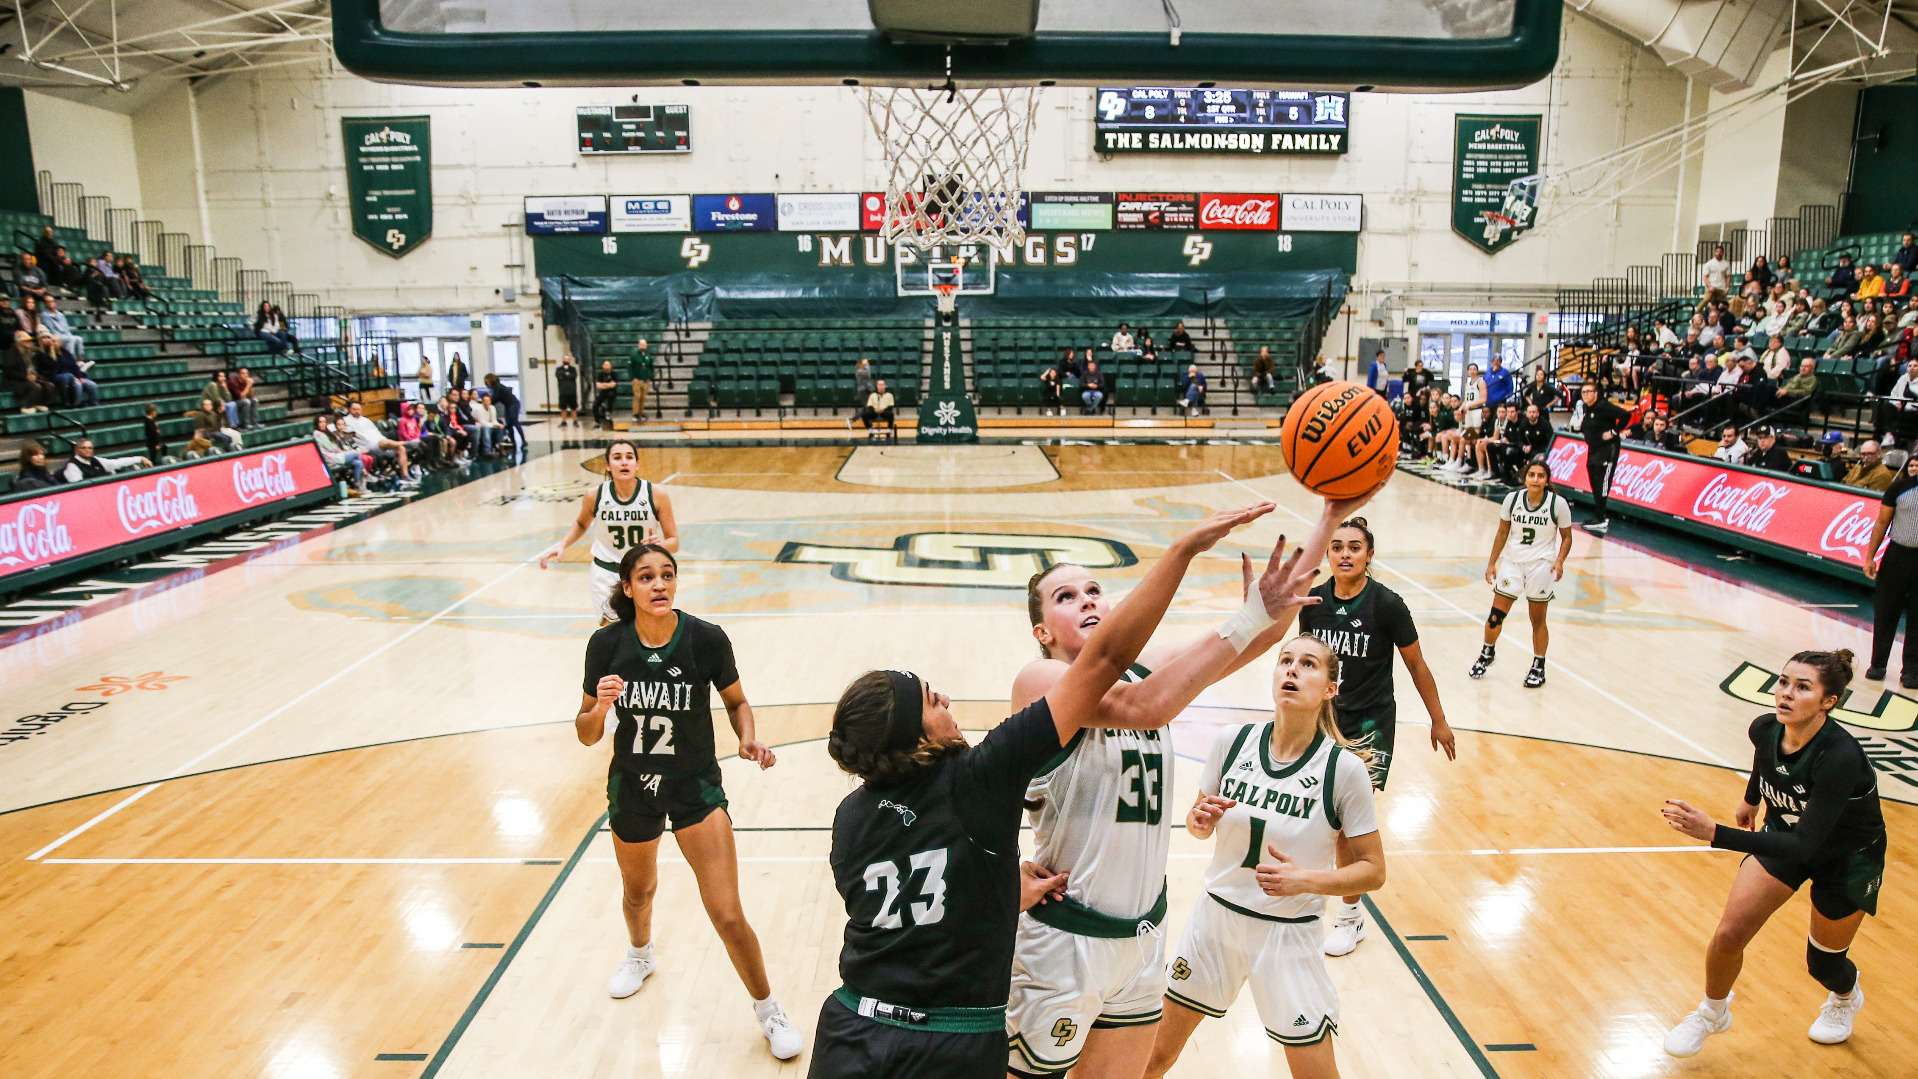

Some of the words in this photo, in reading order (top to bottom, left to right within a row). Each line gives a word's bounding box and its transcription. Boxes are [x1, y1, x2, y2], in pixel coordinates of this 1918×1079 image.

[1132, 90, 1147, 98] CAL
[1149, 90, 1169, 99] POLY
[1204, 91, 1232, 104] 3:25
[665, 105, 687, 114] GUEST
[1145, 105, 1155, 119] 8
[1221, 105, 1236, 113] QTR
[1289, 106, 1299, 120] 5
[365, 132, 380, 145] CAL
[390, 130, 411, 144] POLY
[1105, 133, 1142, 148] THE
[1149, 133, 1264, 149] SALMONSON
[1271, 134, 1341, 150] FAMILY
[1475, 129, 1491, 142] CAL
[1500, 128, 1520, 142] POLY
[627, 201, 670, 210] MGE
[1118, 193, 1194, 201] INJECTORS
[799, 201, 857, 211] CROSSCOUNTRY
[1118, 201, 1170, 211] DIRECT
[1201, 198, 1276, 225] Coca-Cola
[710, 211, 758, 221] Firestone
[602, 236, 618, 254] 15
[797, 235, 812, 252] 16
[1081, 233, 1096, 251] 17
[1277, 234, 1292, 252] 18
[1301, 386, 1365, 443] Wilson
[921, 426, 948, 436] Dignity
[949, 425, 973, 434] Health
[233, 452, 296, 504] Coca-Cola
[117, 473, 198, 534] Coca-Cola
[1693, 473, 1791, 532] Coca-Cola
[601, 511, 621, 521] CAL
[624, 511, 648, 521] POLY
[1512, 514, 1526, 523] CAL
[1528, 515, 1548, 525] POLY
[607, 525, 644, 550] 30
[1520, 527, 1535, 545] 2
[632, 714, 675, 755] 12
[1115, 749, 1163, 826] 33
[1222, 777, 1261, 807] CAL
[1261, 788, 1318, 819] POLY
[1240, 816, 1267, 869] 1
[863, 848, 948, 929] 23
